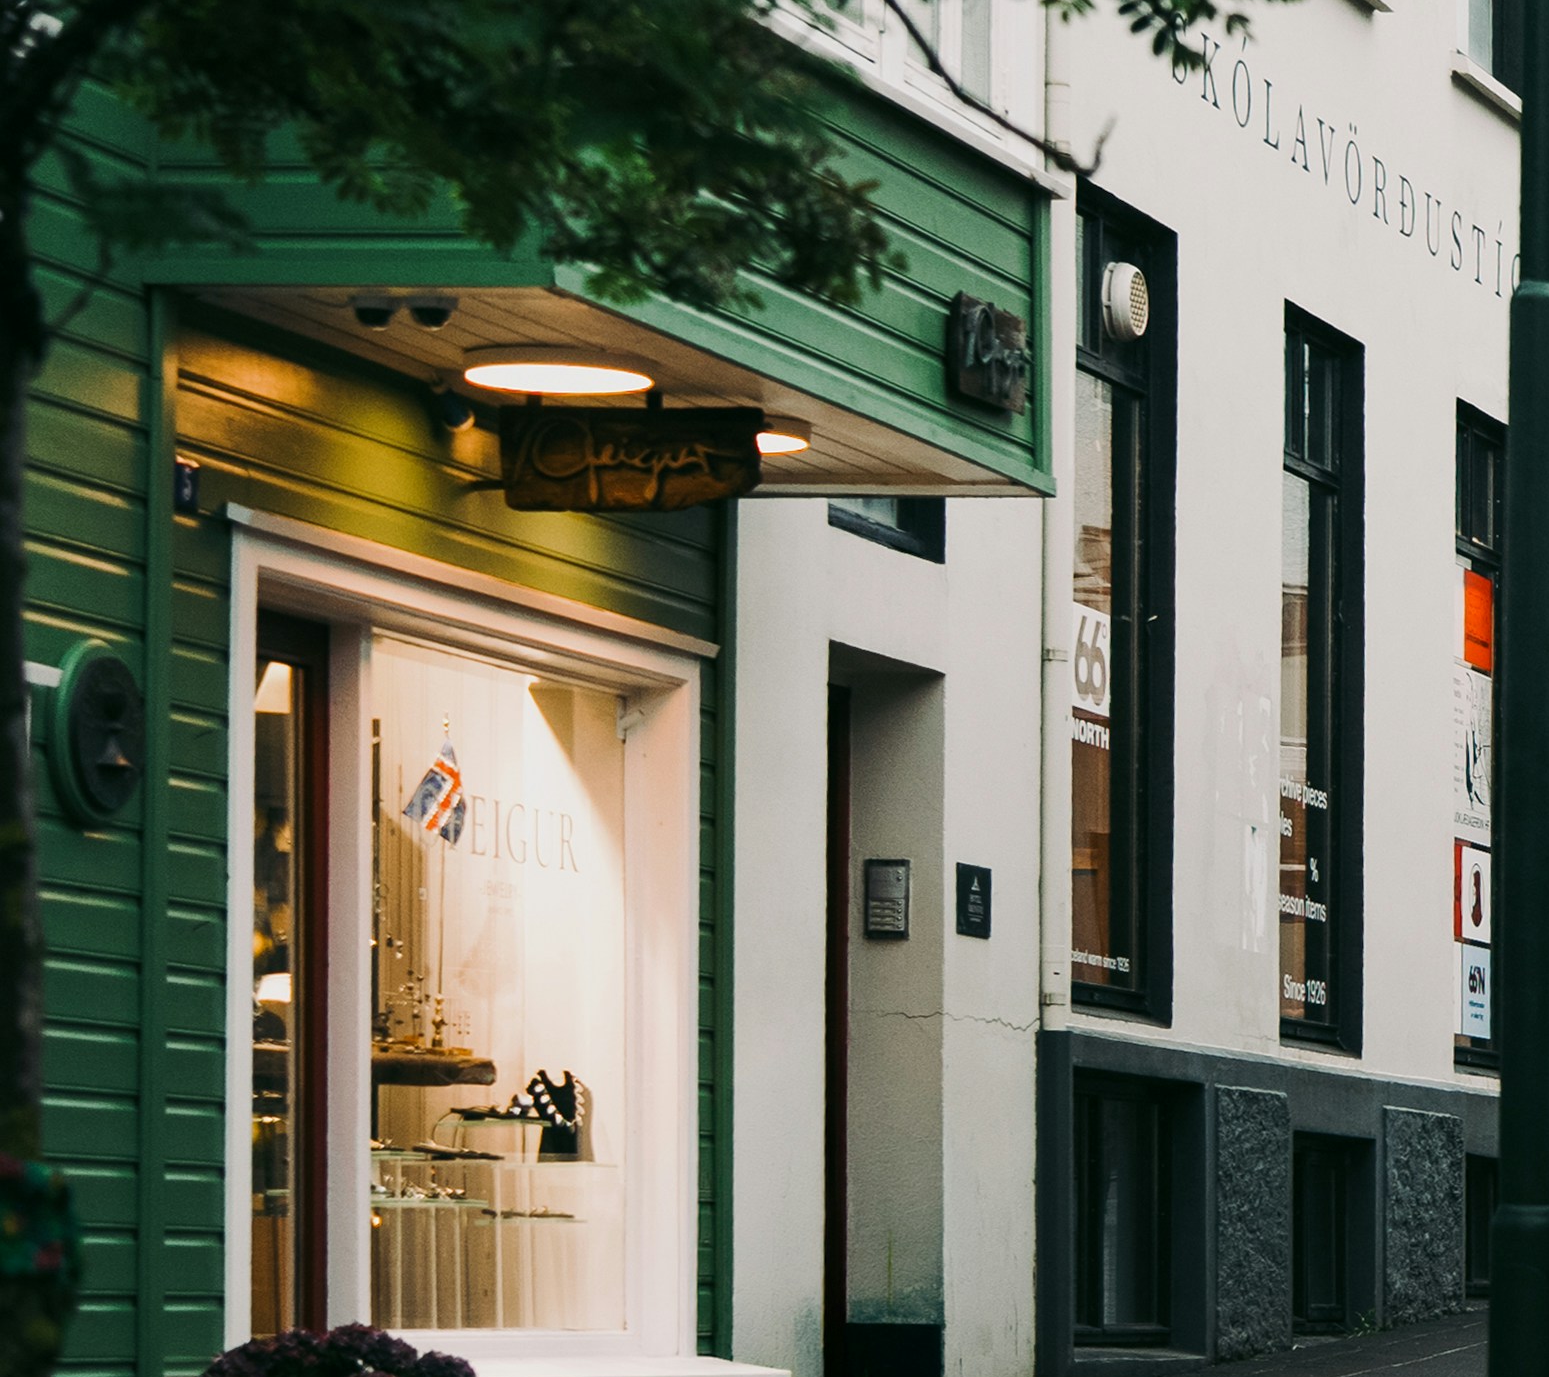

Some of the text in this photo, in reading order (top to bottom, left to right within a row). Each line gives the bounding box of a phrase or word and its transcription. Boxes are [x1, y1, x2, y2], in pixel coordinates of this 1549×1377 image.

[1072, 717, 1110, 751] NORTH
[1302, 781, 1328, 810] pieces
[1309, 857, 1319, 883] %
[1305, 895, 1327, 922] items
[1283, 974, 1327, 1006] Since 1926
